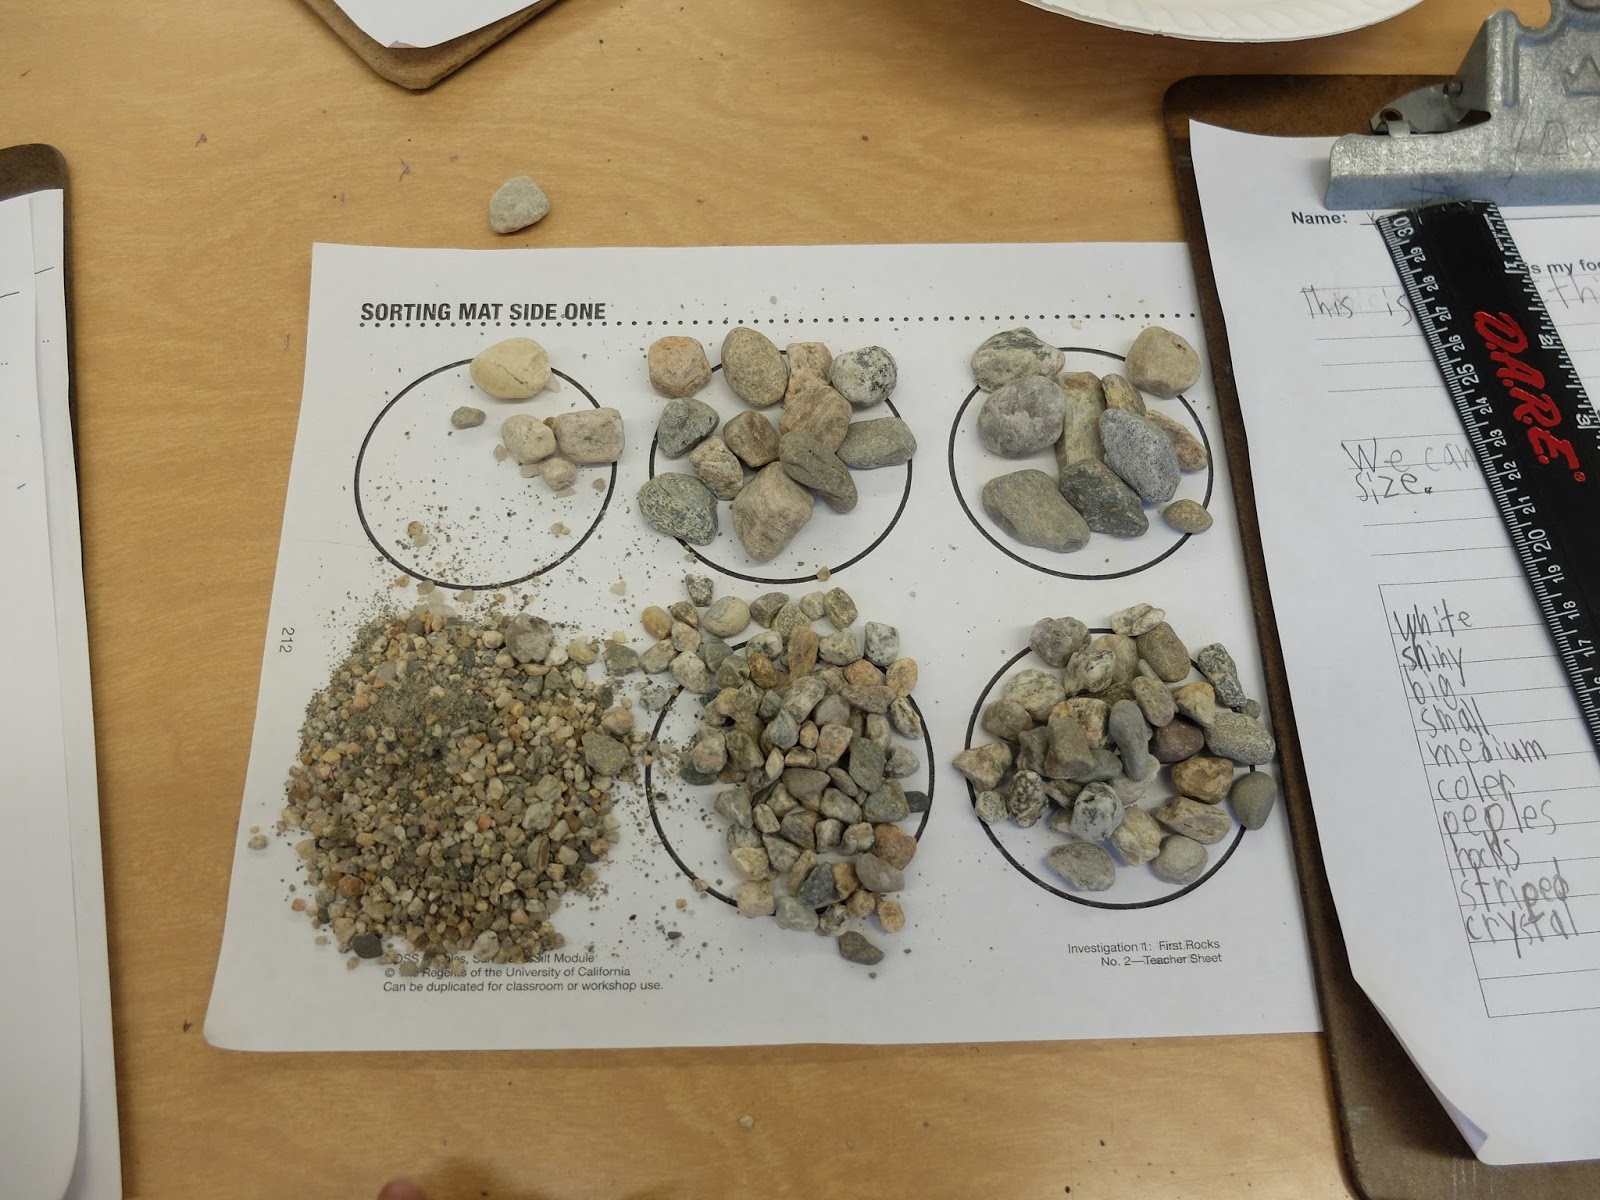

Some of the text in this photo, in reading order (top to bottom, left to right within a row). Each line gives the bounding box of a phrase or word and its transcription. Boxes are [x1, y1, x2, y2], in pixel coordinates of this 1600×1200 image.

[1291, 211, 1348, 225] Name:
[1393, 216, 1414, 237] 30
[1410, 247, 1426, 263] 29
[1547, 262, 1573, 276] my
[1423, 275, 1439, 292] 28
[360, 302, 606, 321] SORTING MAT SIDE ONE
[1382, 287, 1413, 327] is
[1435, 306, 1452, 322] 27
[1448, 335, 1465, 352] 26
[1456, 363, 1480, 386] 25
[1475, 396, 1493, 415] 24
[1489, 428, 1507, 448] 23
[1341, 437, 1410, 473] We
[1503, 460, 1521, 480] 22
[1518, 495, 1536, 514] 21
[1528, 529, 1552, 552] 20
[1547, 564, 1565, 583] 19
[1562, 600, 1580, 620] 18
[1393, 598, 1472, 642] white
[279, 627, 295, 653] 212
[1578, 639, 1595, 657] 17
[1402, 640, 1465, 687] shiny
[1403, 663, 1457, 711] big
[1421, 696, 1490, 738] small
[1067, 943, 1138, 955] Investigation
[1159, 940, 1183, 951] First
[1186, 939, 1220, 950] Rocks
[554, 952, 595, 963] Module
[1101, 956, 1121, 967] No.
[1190, 953, 1222, 964] Sheet
[470, 967, 482, 977] of
[485, 967, 503, 977] the
[506, 967, 561, 979] University
[563, 967, 576, 977] of
[578, 966, 631, 977] California
[383, 980, 664, 994] Can be duplicated for classroom or workshop use.
